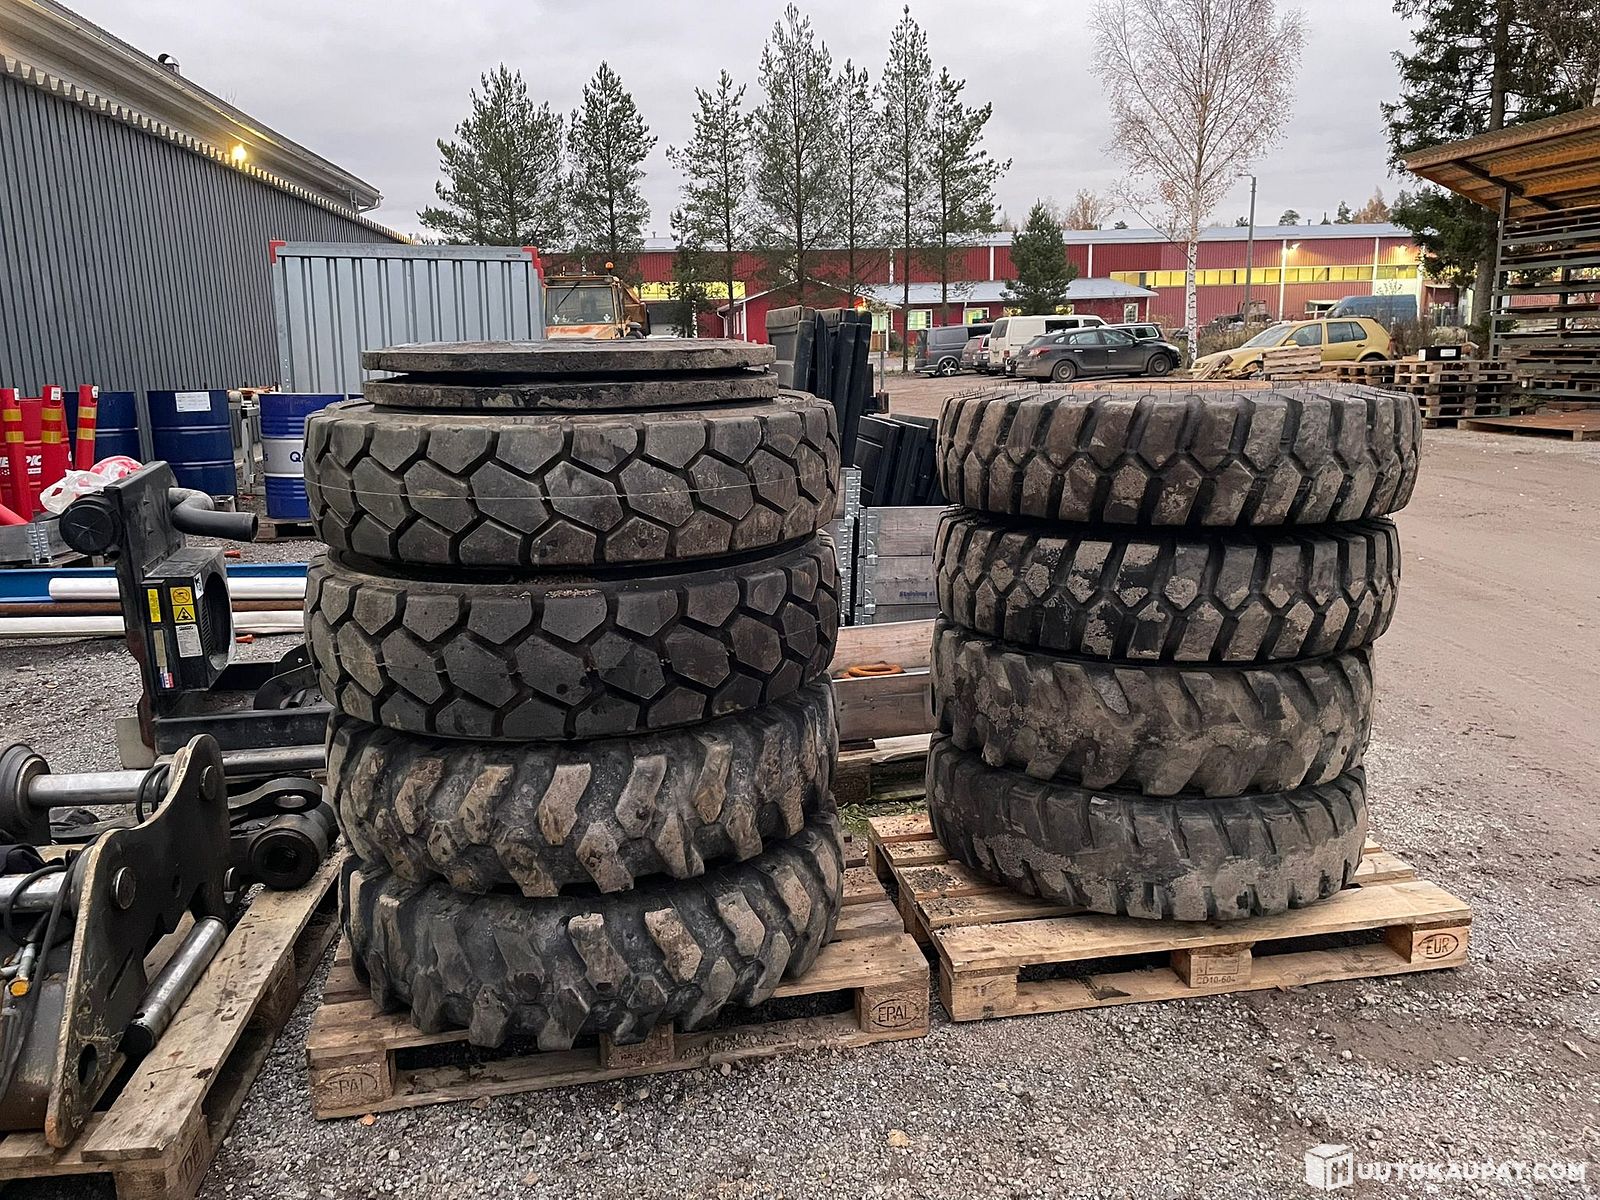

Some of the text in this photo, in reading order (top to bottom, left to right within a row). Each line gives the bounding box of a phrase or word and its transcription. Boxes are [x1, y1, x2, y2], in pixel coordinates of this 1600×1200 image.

[290, 451, 304, 463] Q
[1426, 937, 1450, 955] EUR
[878, 1004, 912, 1023] EPAL
